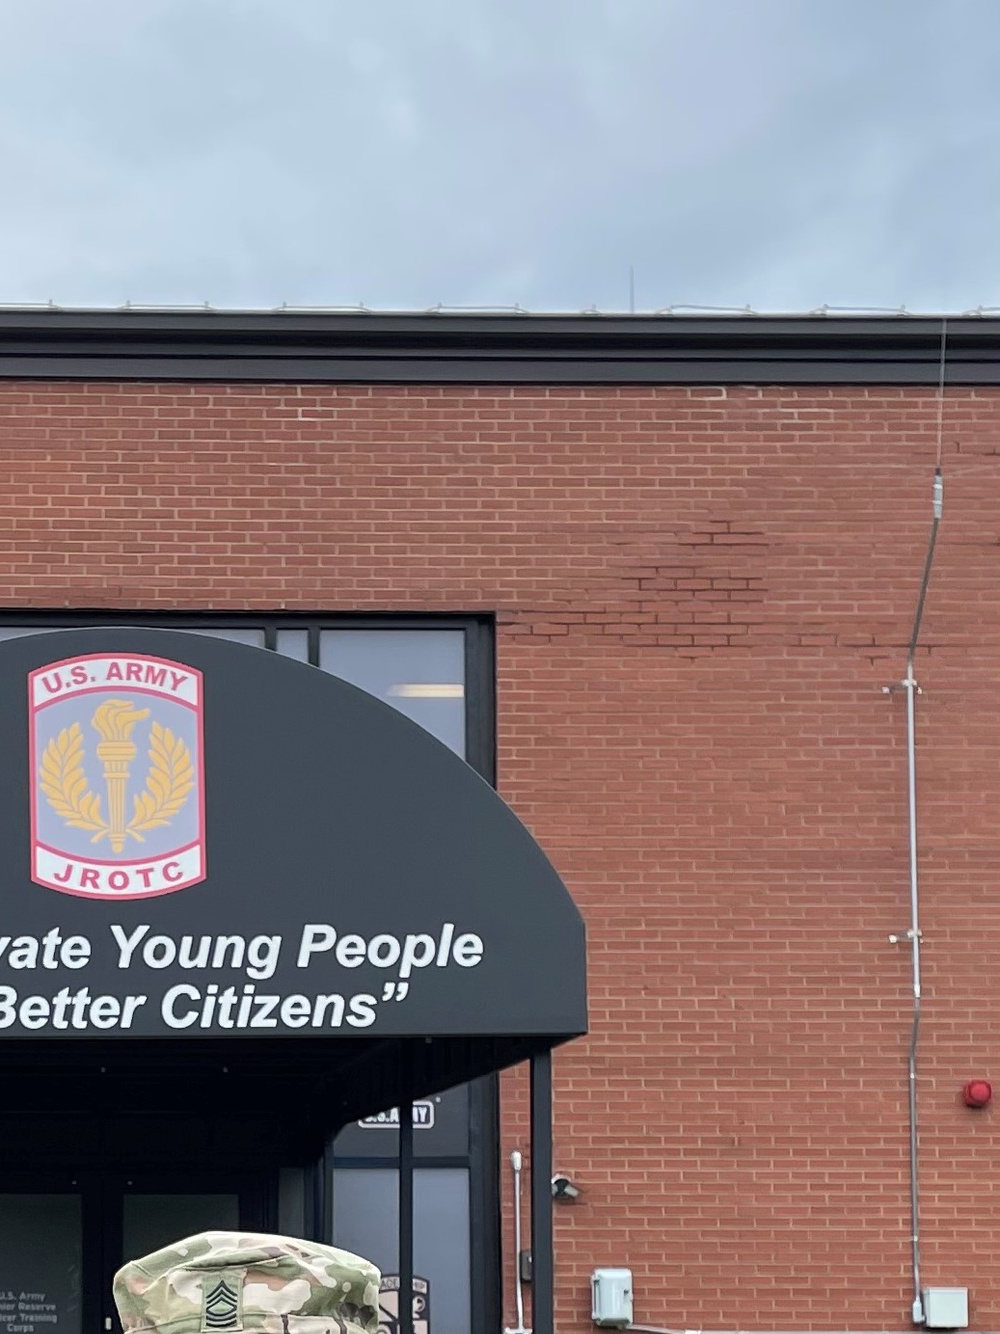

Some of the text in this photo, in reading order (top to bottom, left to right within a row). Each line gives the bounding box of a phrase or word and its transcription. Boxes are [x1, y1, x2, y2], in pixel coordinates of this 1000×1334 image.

[42, 661, 188, 694] U.S. ARMY
[53, 861, 185, 891] JROTC
[109, 924, 283, 980] Young
[296, 922, 485, 978] People
[160, 981, 411, 1029] Citizens”
[18, 1291, 46, 1302] Army
[18, 1302, 56, 1311] Reserve
[6, 1323, 35, 1333] Corps
[19, 1313, 58, 1324] Training
